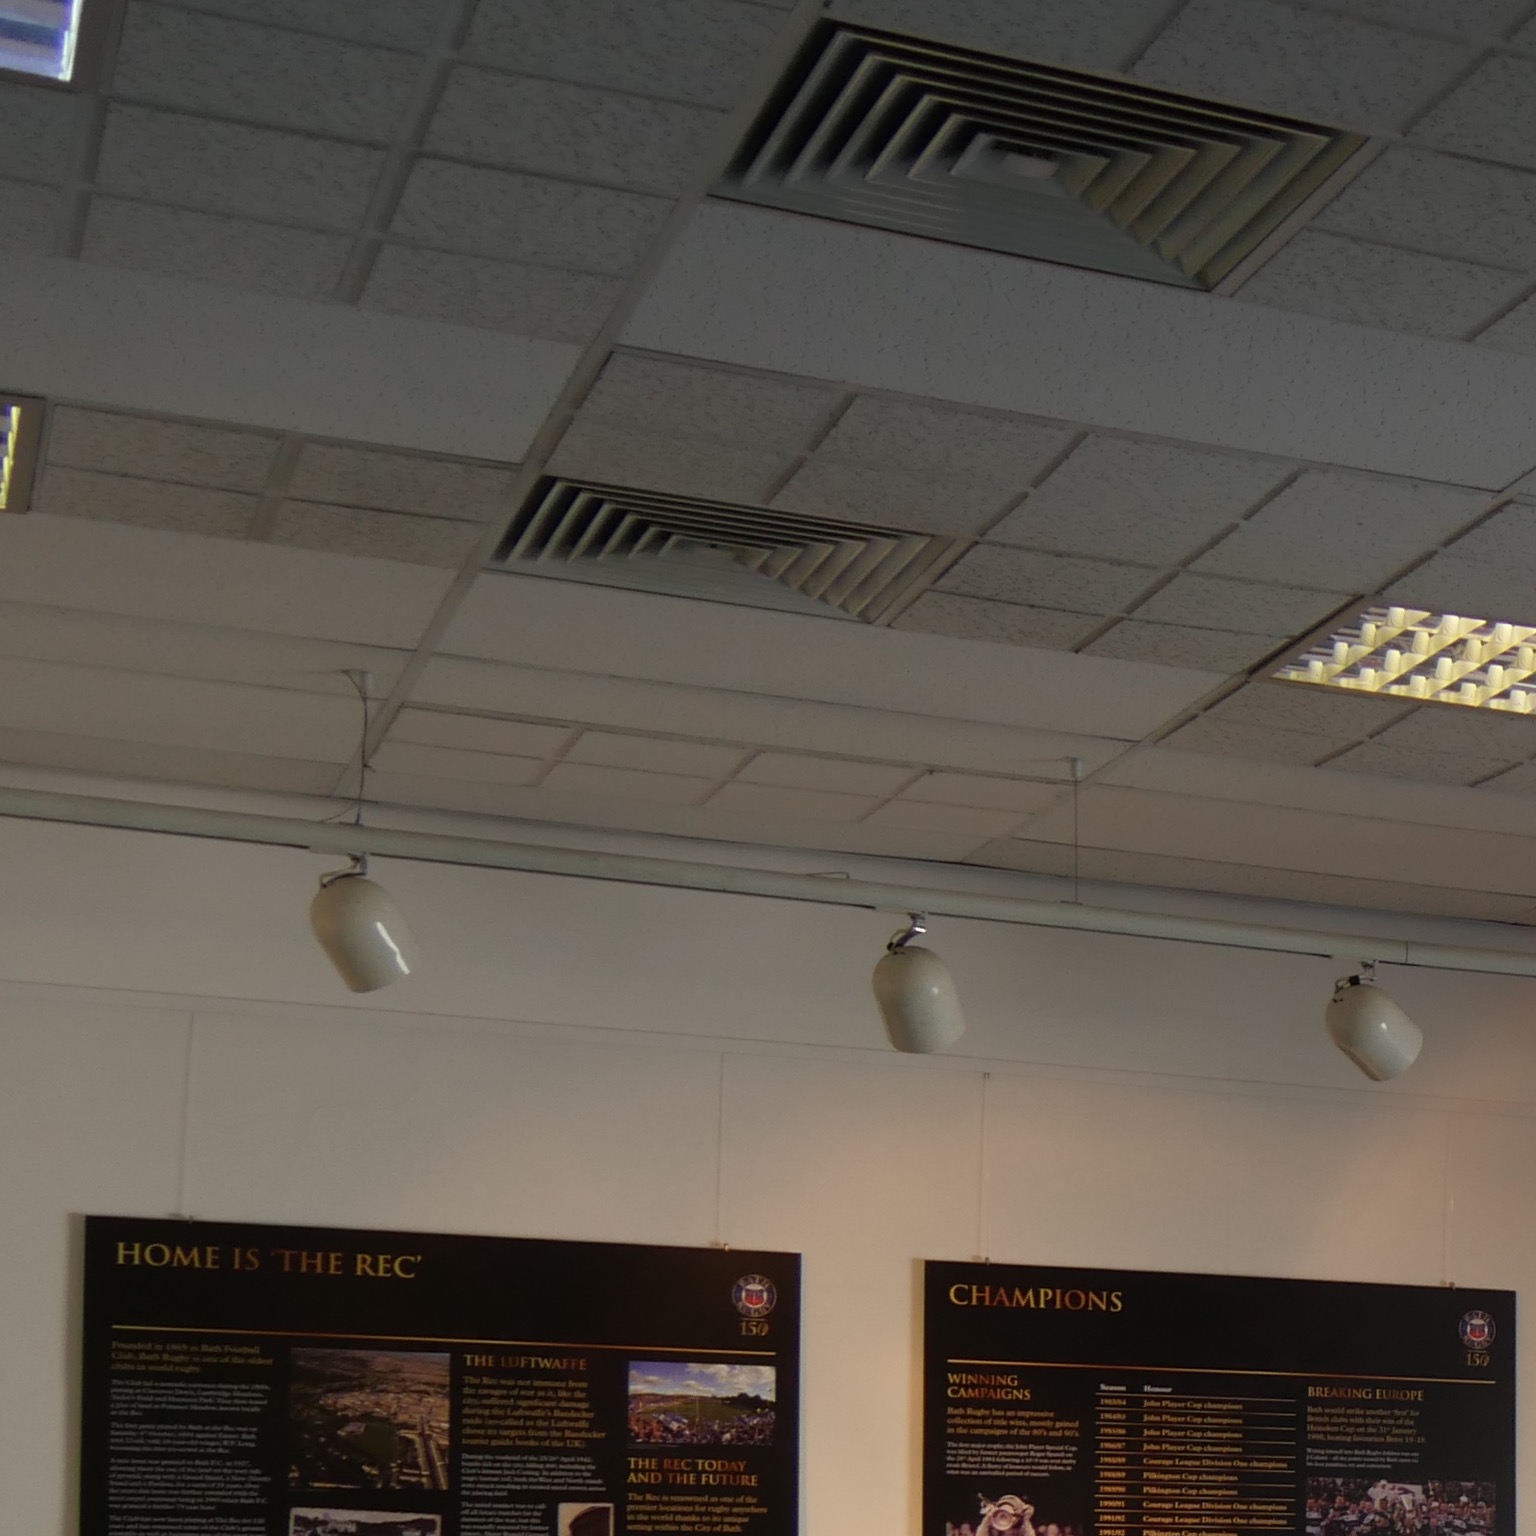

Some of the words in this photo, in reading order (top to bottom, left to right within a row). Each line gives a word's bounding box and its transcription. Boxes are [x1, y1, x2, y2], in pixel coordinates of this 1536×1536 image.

[116, 1241, 221, 1270] HOME
[232, 1248, 260, 1271] IS
[949, 1283, 1123, 1313] CHAMPIONS
[740, 1321, 770, 1337] 150
[463, 1354, 495, 1368] THE
[501, 1355, 589, 1371] LUFTWAFFE
[1466, 1352, 1490, 1367] 150
[947, 1372, 1019, 1387] WINNING
[947, 1386, 1032, 1401] CAMPAIGNS
[1100, 1383, 1127, 1393] Season
[1143, 1384, 1173, 1394] Honour
[1307, 1385, 1373, 1400] BREAKING
[1376, 1387, 1425, 1402] EUROPE
[627, 1457, 659, 1470] THE
[663, 1458, 692, 1471] REC
[695, 1458, 748, 1473] TODAY
[626, 1471, 662, 1484] AND
[666, 1472, 698, 1485] THE
[700, 1473, 759, 1487] FUTURE
